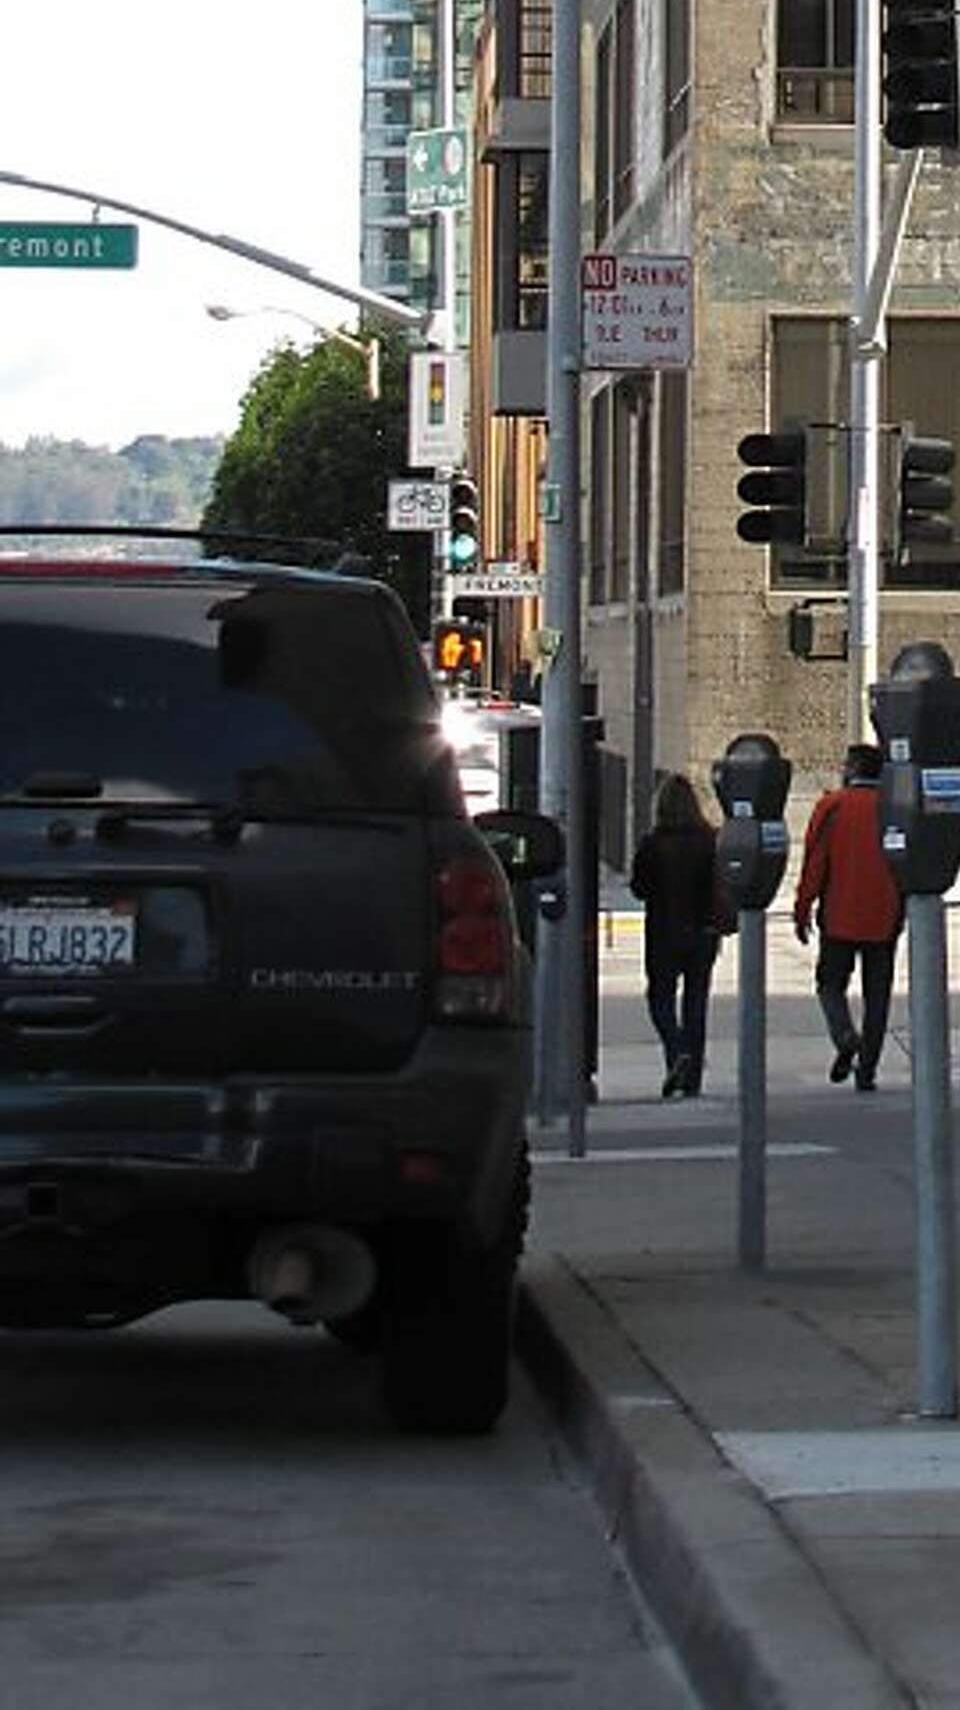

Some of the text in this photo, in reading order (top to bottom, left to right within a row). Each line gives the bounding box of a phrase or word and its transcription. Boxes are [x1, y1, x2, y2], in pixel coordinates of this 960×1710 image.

[586, 259, 688, 288] NO PARKING
[251, 969, 420, 989] CHEVROLET
